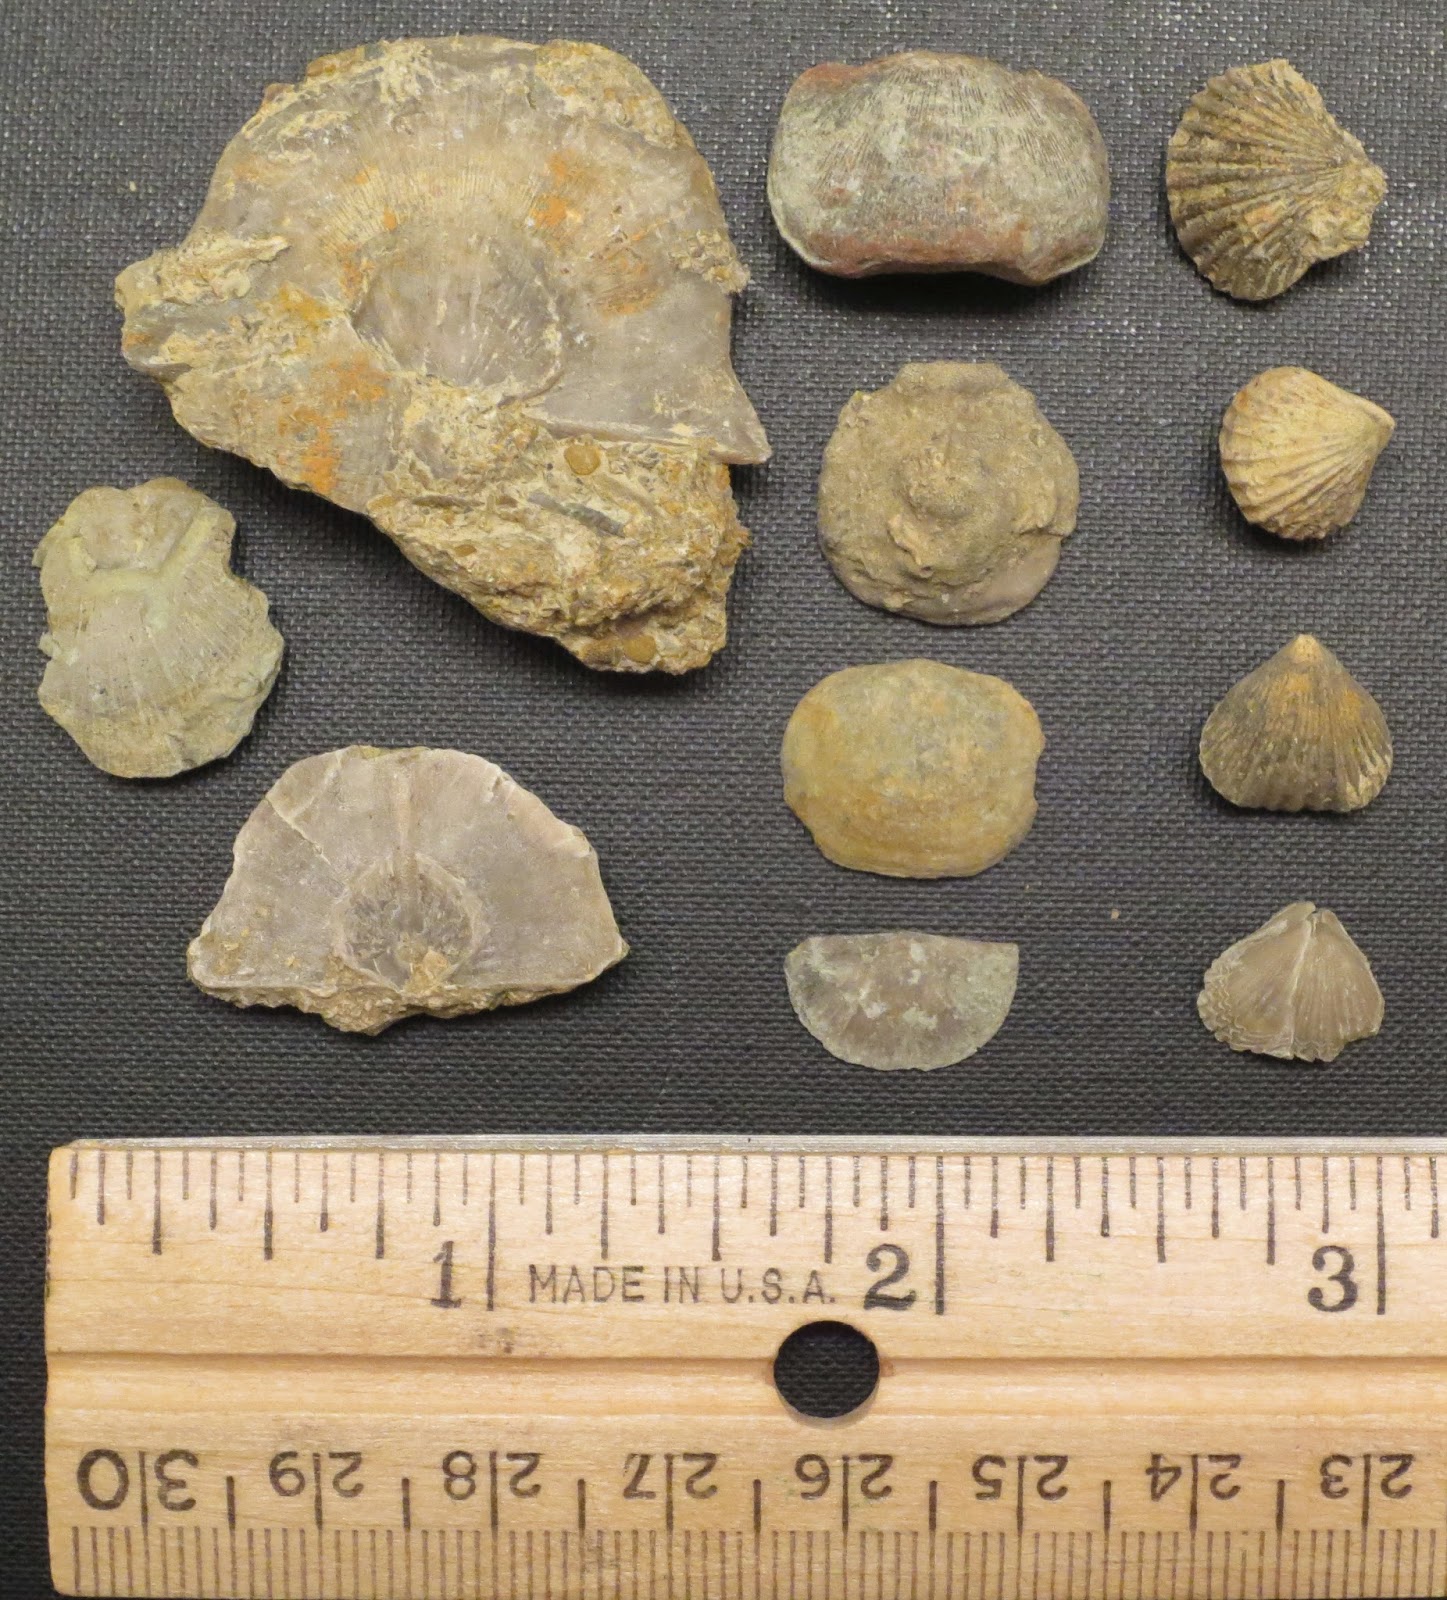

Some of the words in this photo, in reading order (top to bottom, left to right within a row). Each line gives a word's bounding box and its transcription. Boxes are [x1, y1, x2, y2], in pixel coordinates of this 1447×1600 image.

[430, 1240, 462, 1309] 1
[528, 1264, 646, 1304] MADE
[663, 1265, 701, 1304] IN
[720, 1267, 837, 1305] U.S.A.
[863, 1243, 918, 1311] 2
[1307, 1244, 1358, 1313] 3
[76, 1448, 200, 1511] 30
[268, 1450, 364, 1498] 29
[441, 1449, 543, 1500] 28
[622, 1452, 719, 1500] 27
[794, 1453, 894, 1500] 26
[971, 1454, 1069, 1501] 25
[1144, 1453, 1241, 1501] 24
[1319, 1453, 1416, 1500] 23
